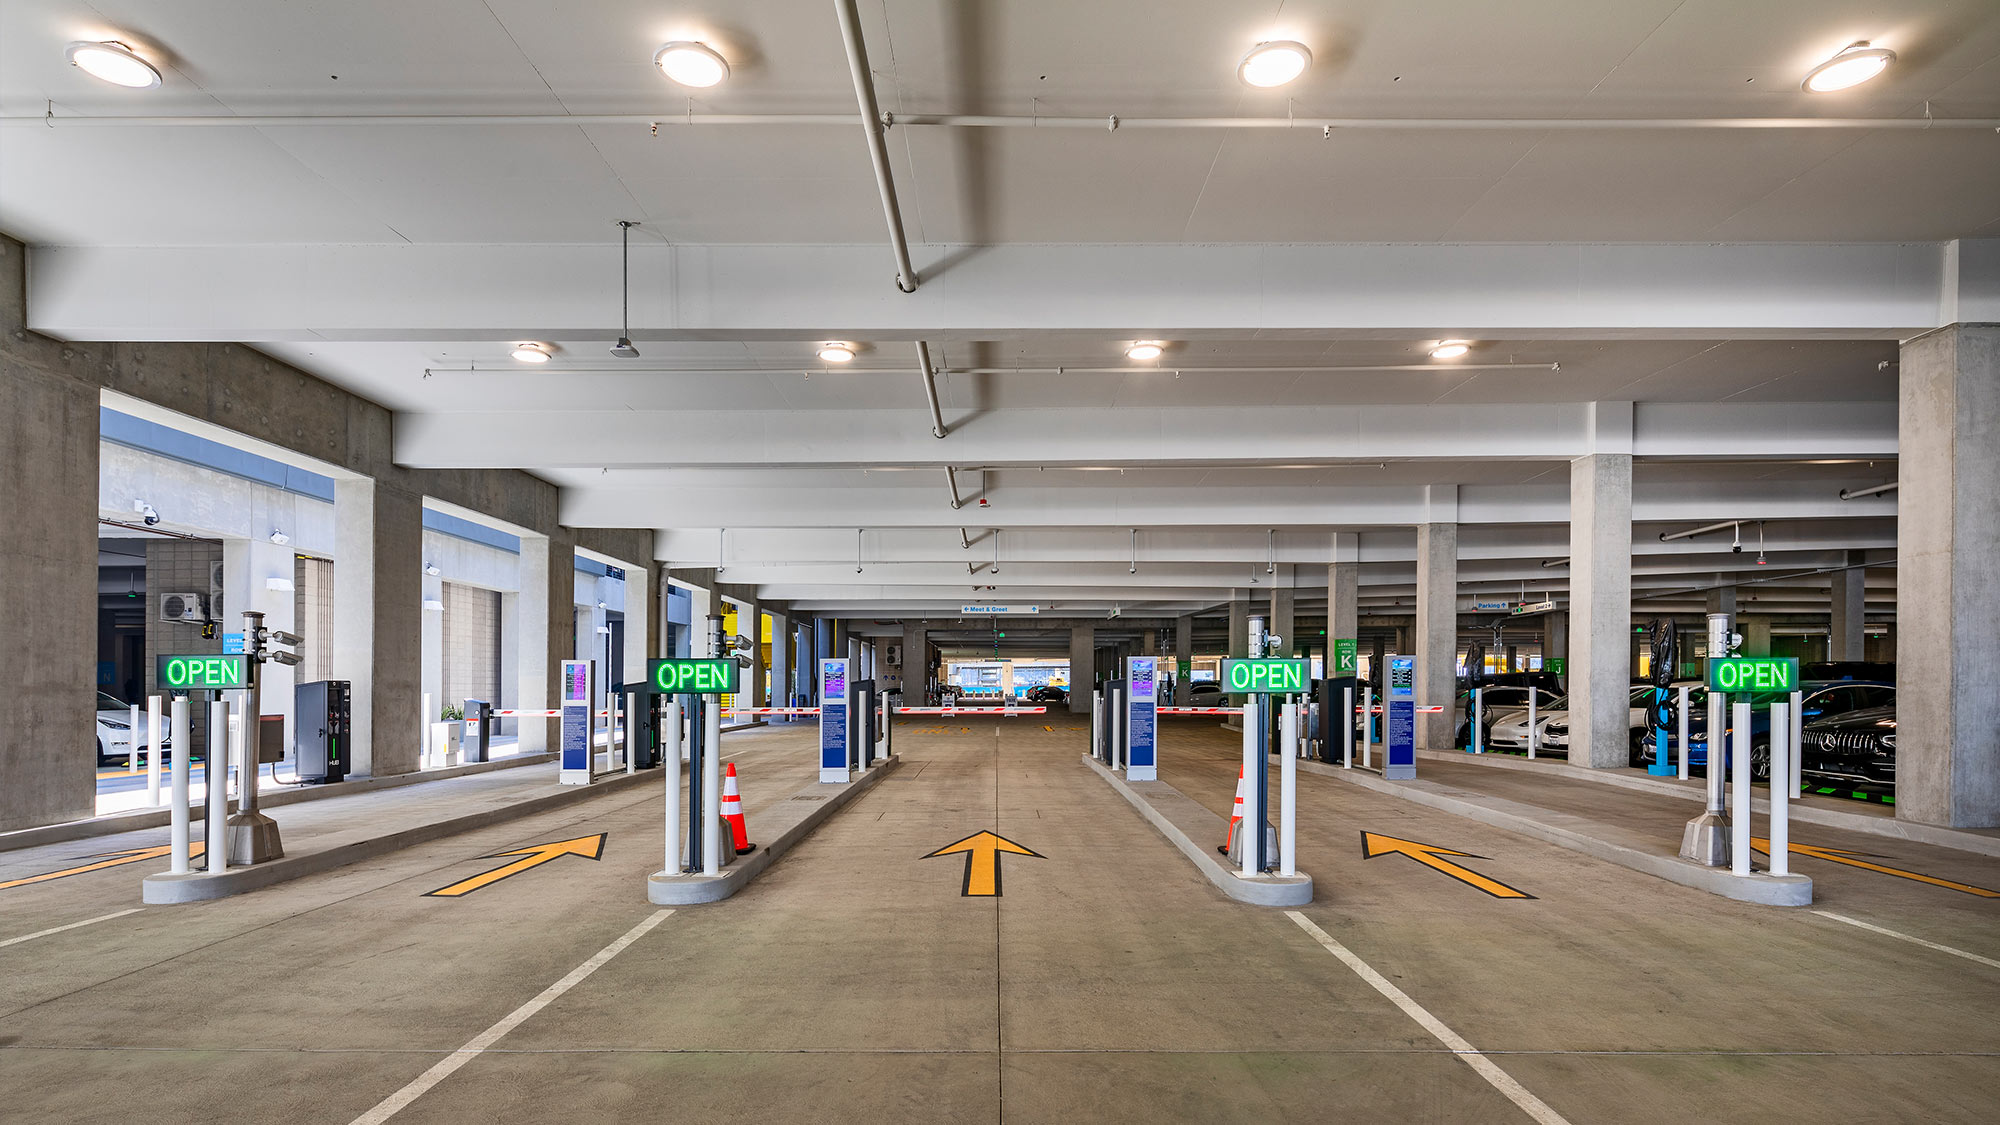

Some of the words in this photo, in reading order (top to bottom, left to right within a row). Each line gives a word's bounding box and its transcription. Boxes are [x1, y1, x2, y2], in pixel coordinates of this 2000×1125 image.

[166, 659, 239, 684] OPEN
[1182, 669, 1188, 677] K
[1341, 655, 1352, 668] K
[657, 662, 730, 690] OPEN
[1231, 662, 1303, 689] OPEN
[1719, 662, 1788, 687] OPEN
